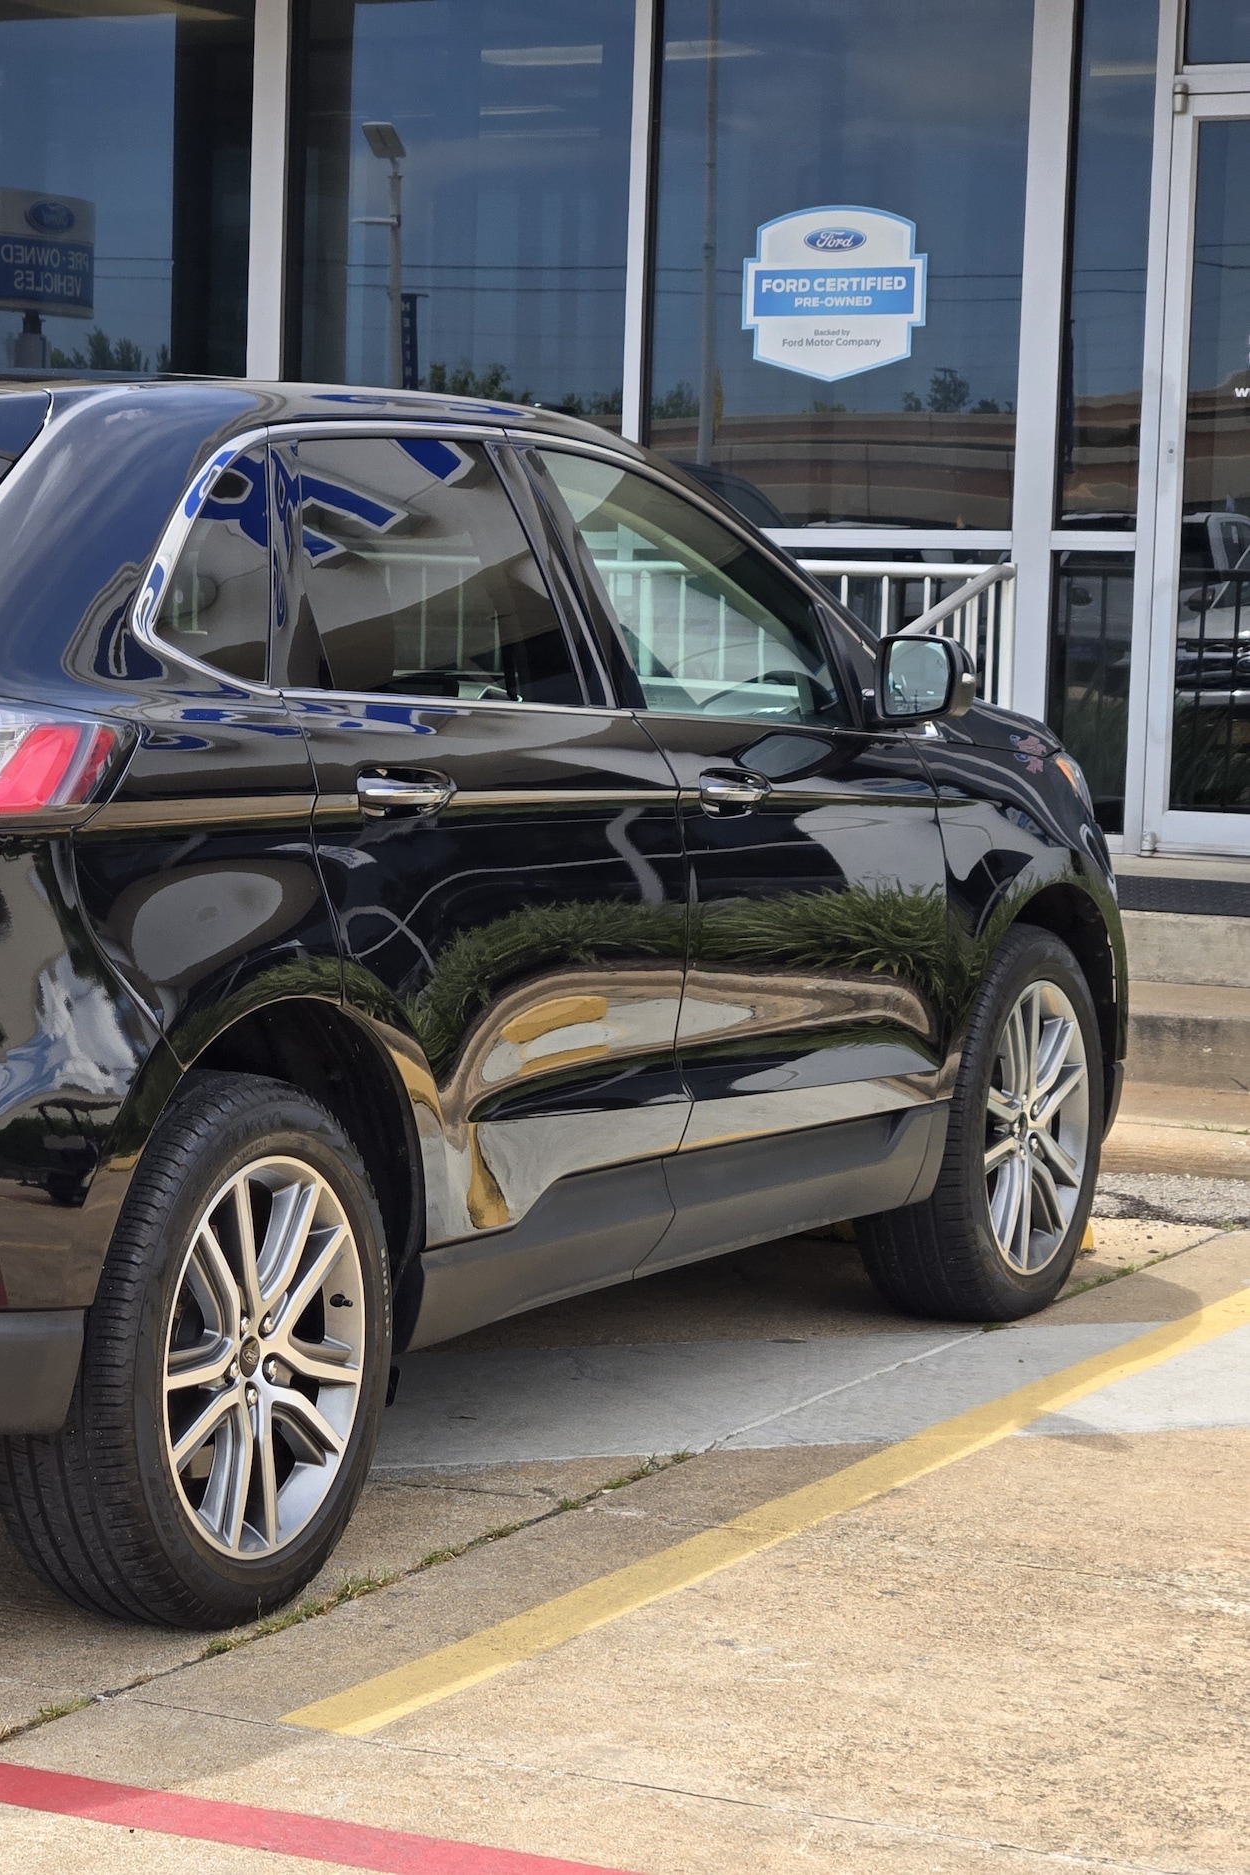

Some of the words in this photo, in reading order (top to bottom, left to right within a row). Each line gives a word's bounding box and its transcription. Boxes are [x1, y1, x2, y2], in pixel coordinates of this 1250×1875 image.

[816, 231, 855, 249] Ford
[762, 278, 811, 293] FORD
[813, 276, 907, 292] CERTIFIED
[794, 296, 872, 308] PRE-OWNED
[813, 329, 840, 337] Backed
[841, 329, 850, 338] by
[781, 338, 803, 348] Ford
[805, 337, 834, 347] Motor
[835, 337, 882, 350] Company
